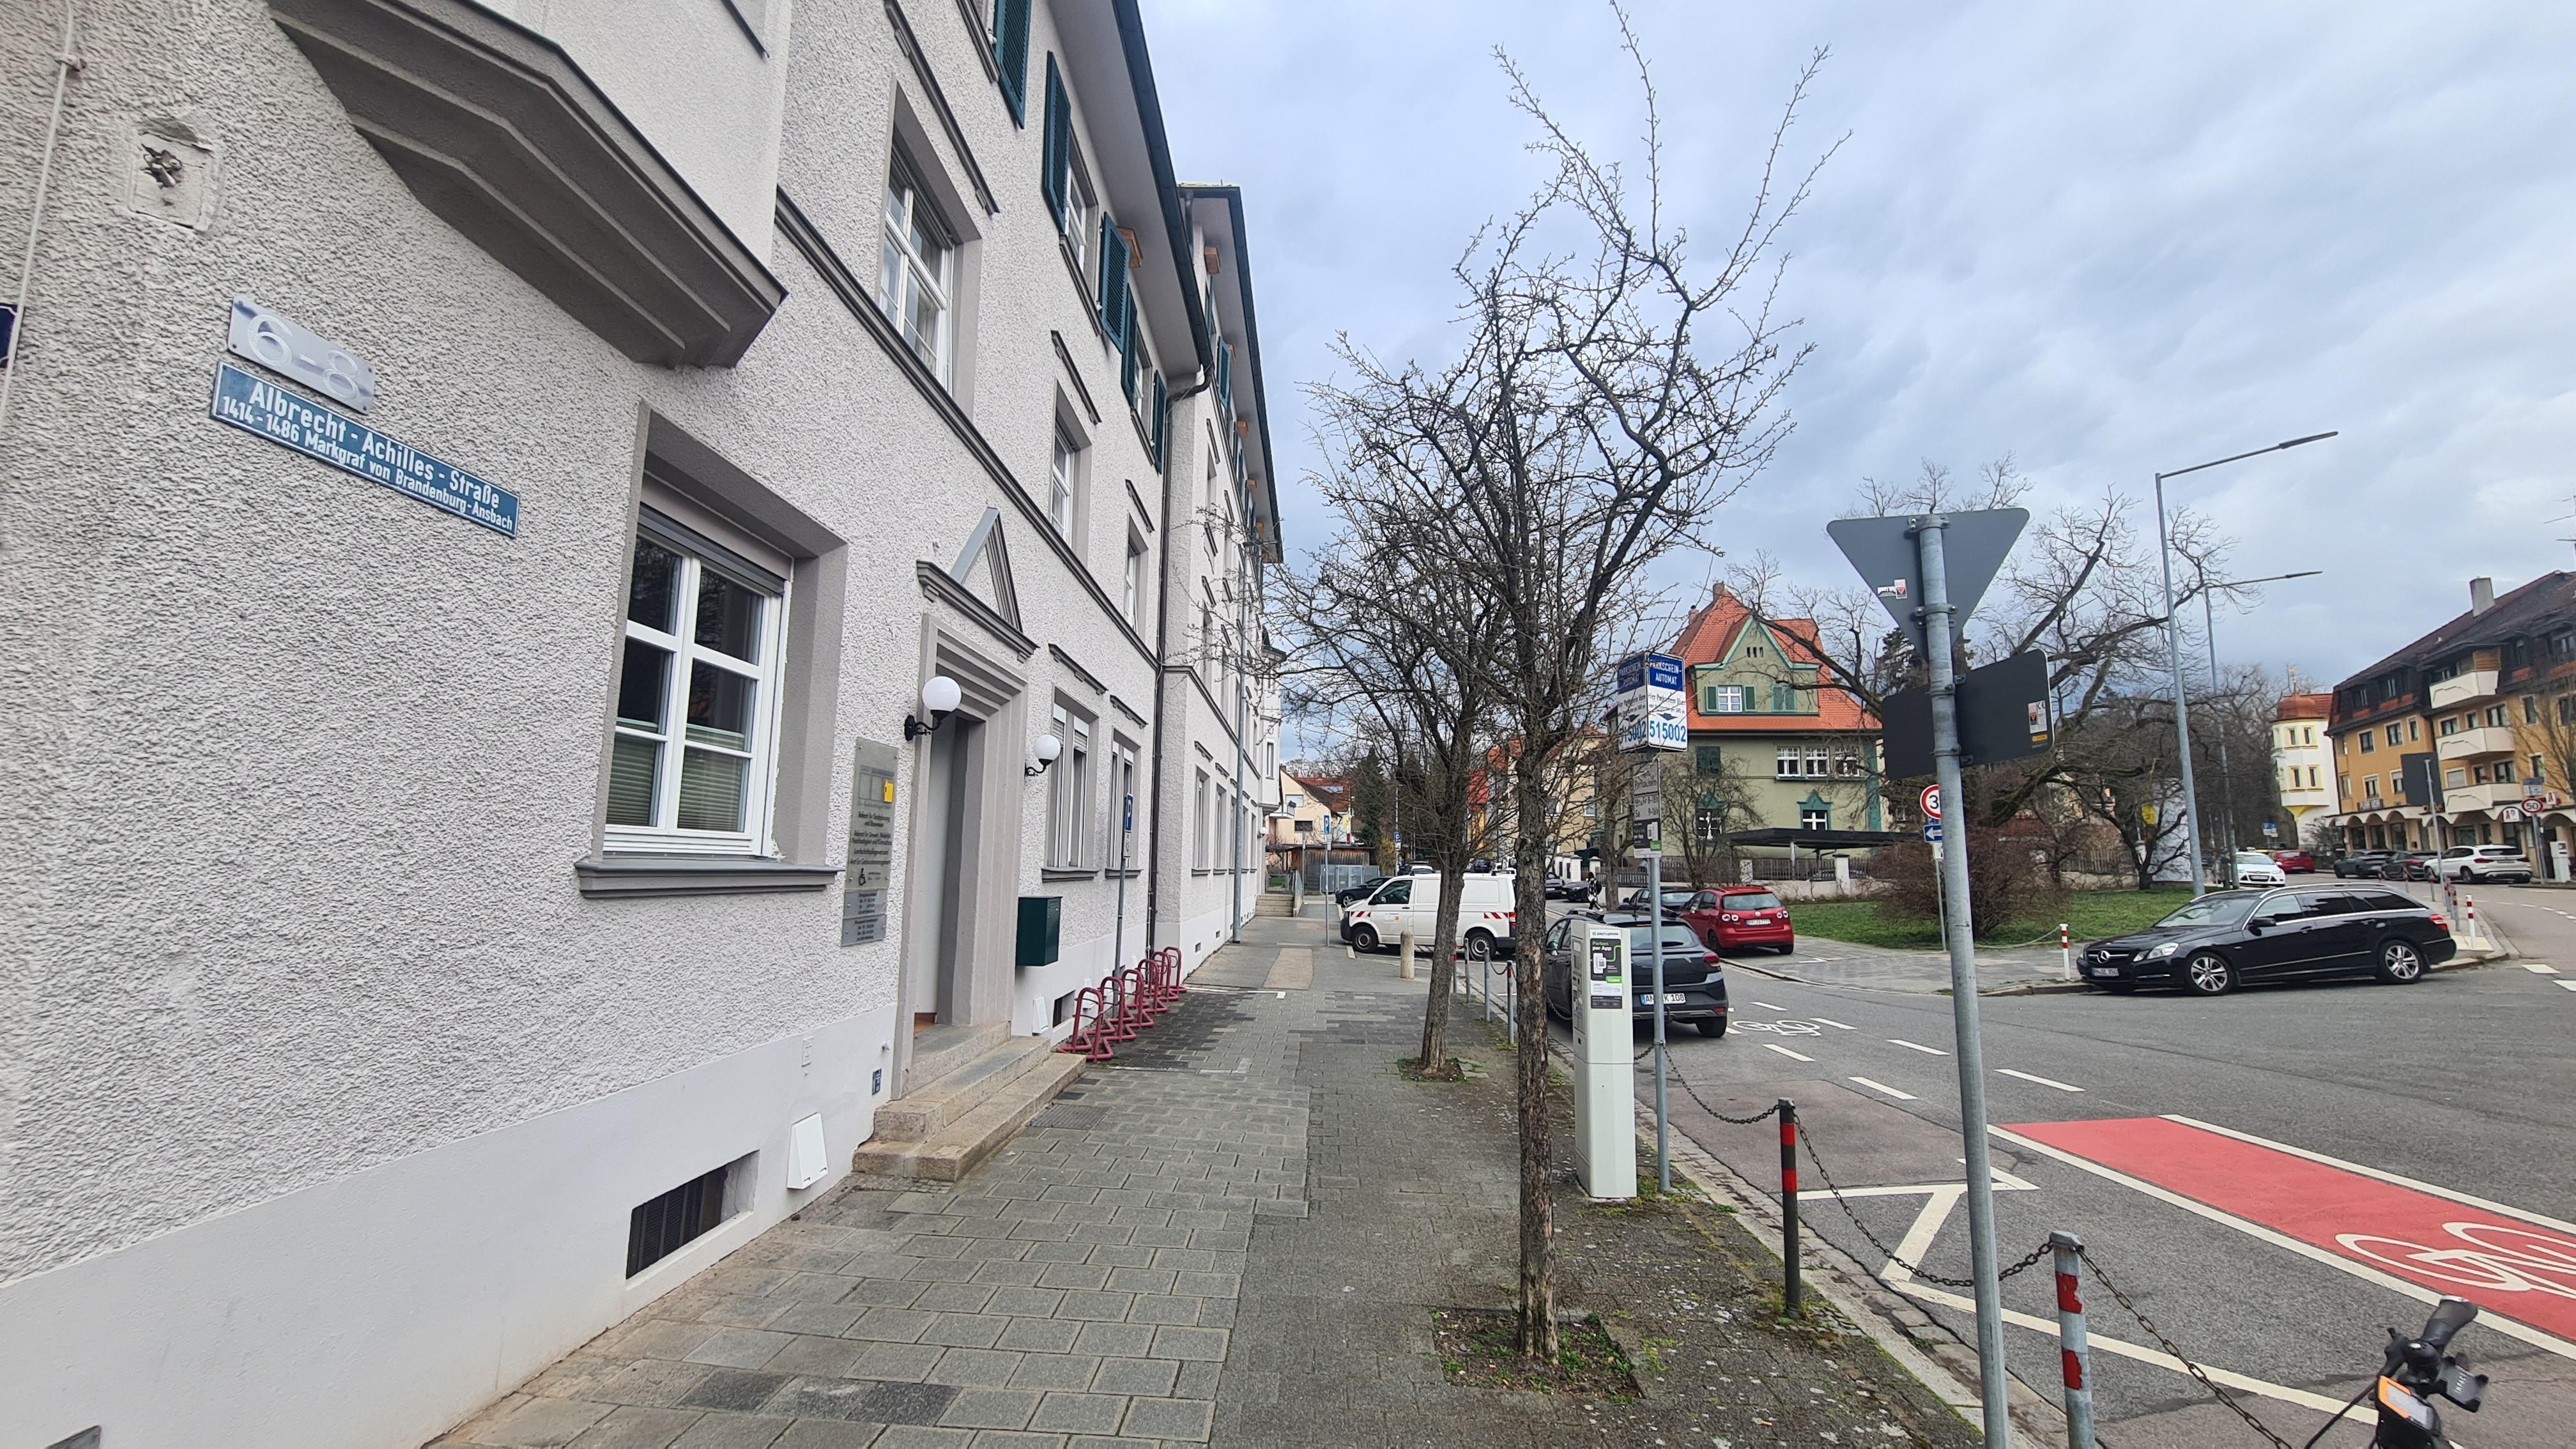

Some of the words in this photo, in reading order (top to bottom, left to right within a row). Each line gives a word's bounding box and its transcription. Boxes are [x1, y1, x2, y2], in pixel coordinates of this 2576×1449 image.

[249, 381, 348, 442] Albrecht
[362, 432, 434, 480] Achilles
[449, 470, 500, 509] Straße
[304, 429, 366, 469] Markgraf
[369, 460, 391, 481] von
[1655, 673, 1677, 686] AUTOMAT
[1649, 720, 1686, 742] 515002
[1929, 794, 1939, 809] 3
[1670, 993, 1685, 1002] 108
